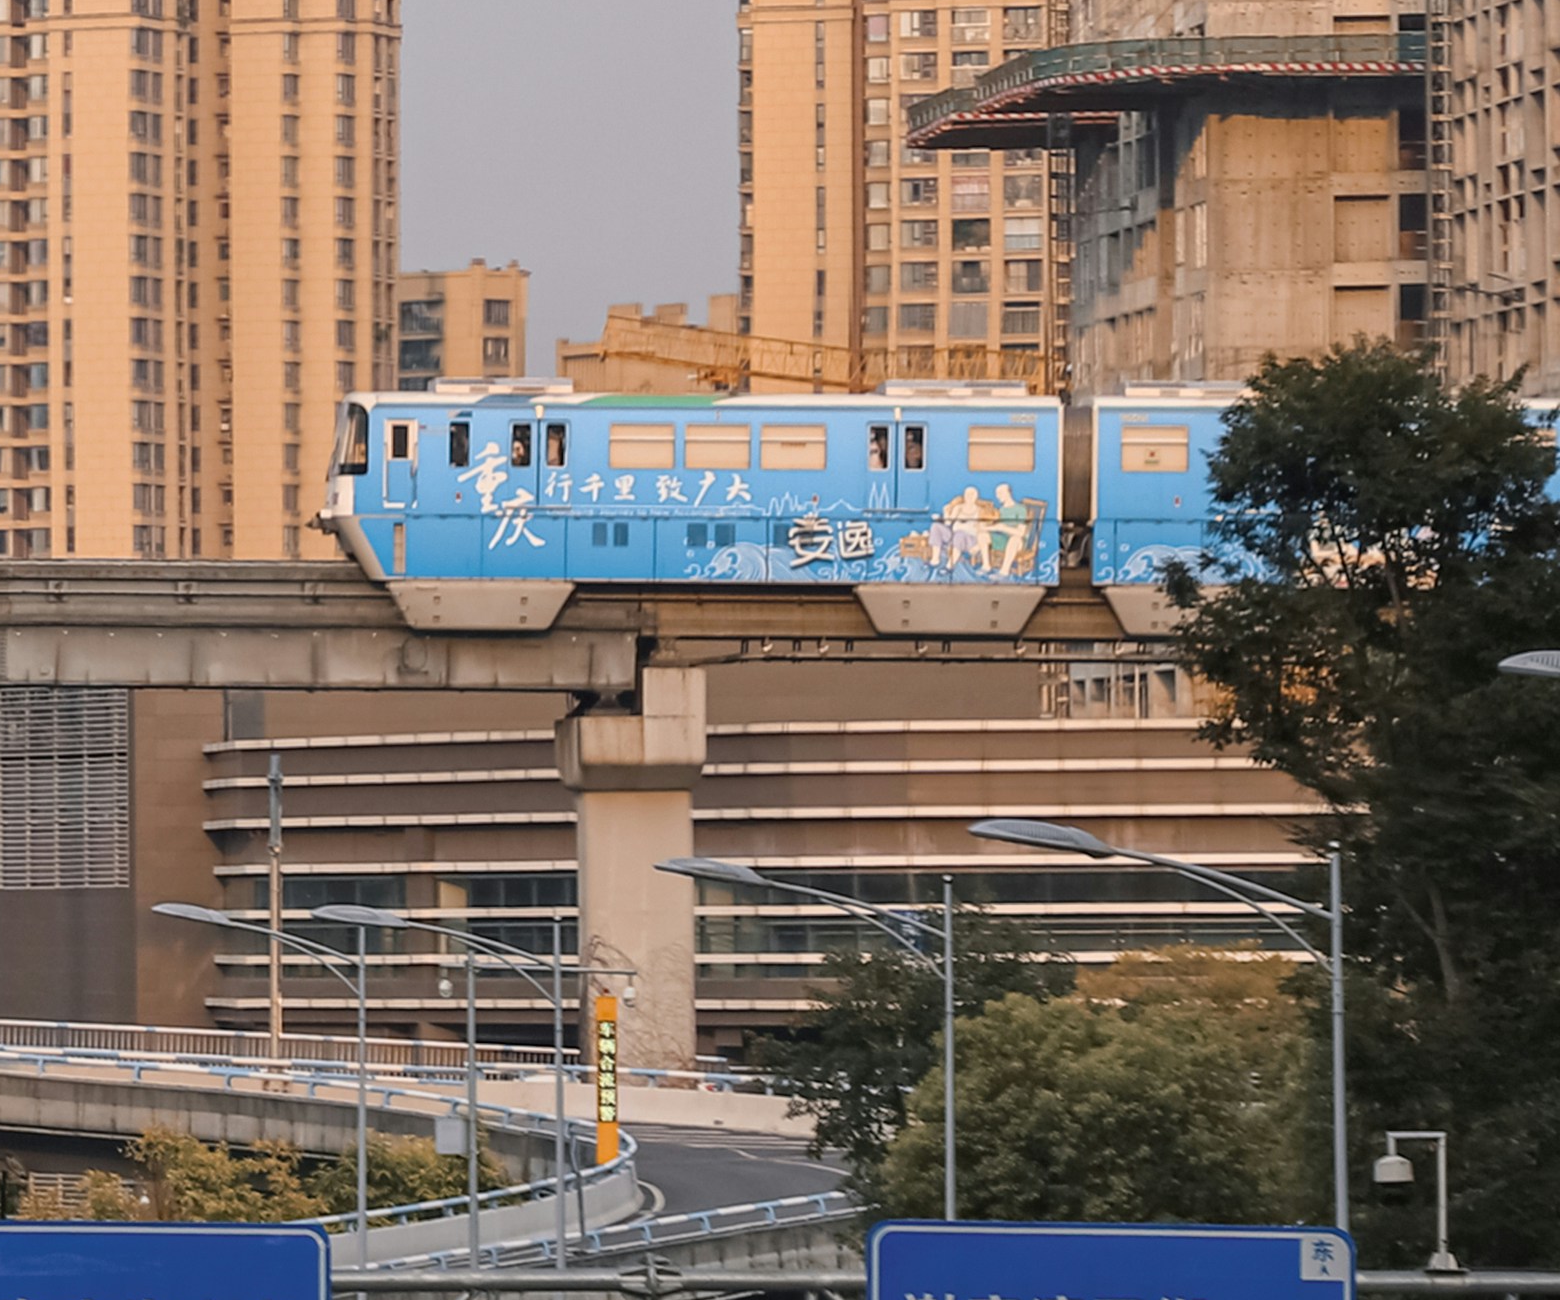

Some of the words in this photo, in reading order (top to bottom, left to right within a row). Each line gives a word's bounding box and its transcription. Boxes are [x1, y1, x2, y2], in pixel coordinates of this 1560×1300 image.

[457, 442, 545, 549] 重庆
[787, 517, 875, 570] 安逸
[1312, 1240, 1334, 1265] 东
